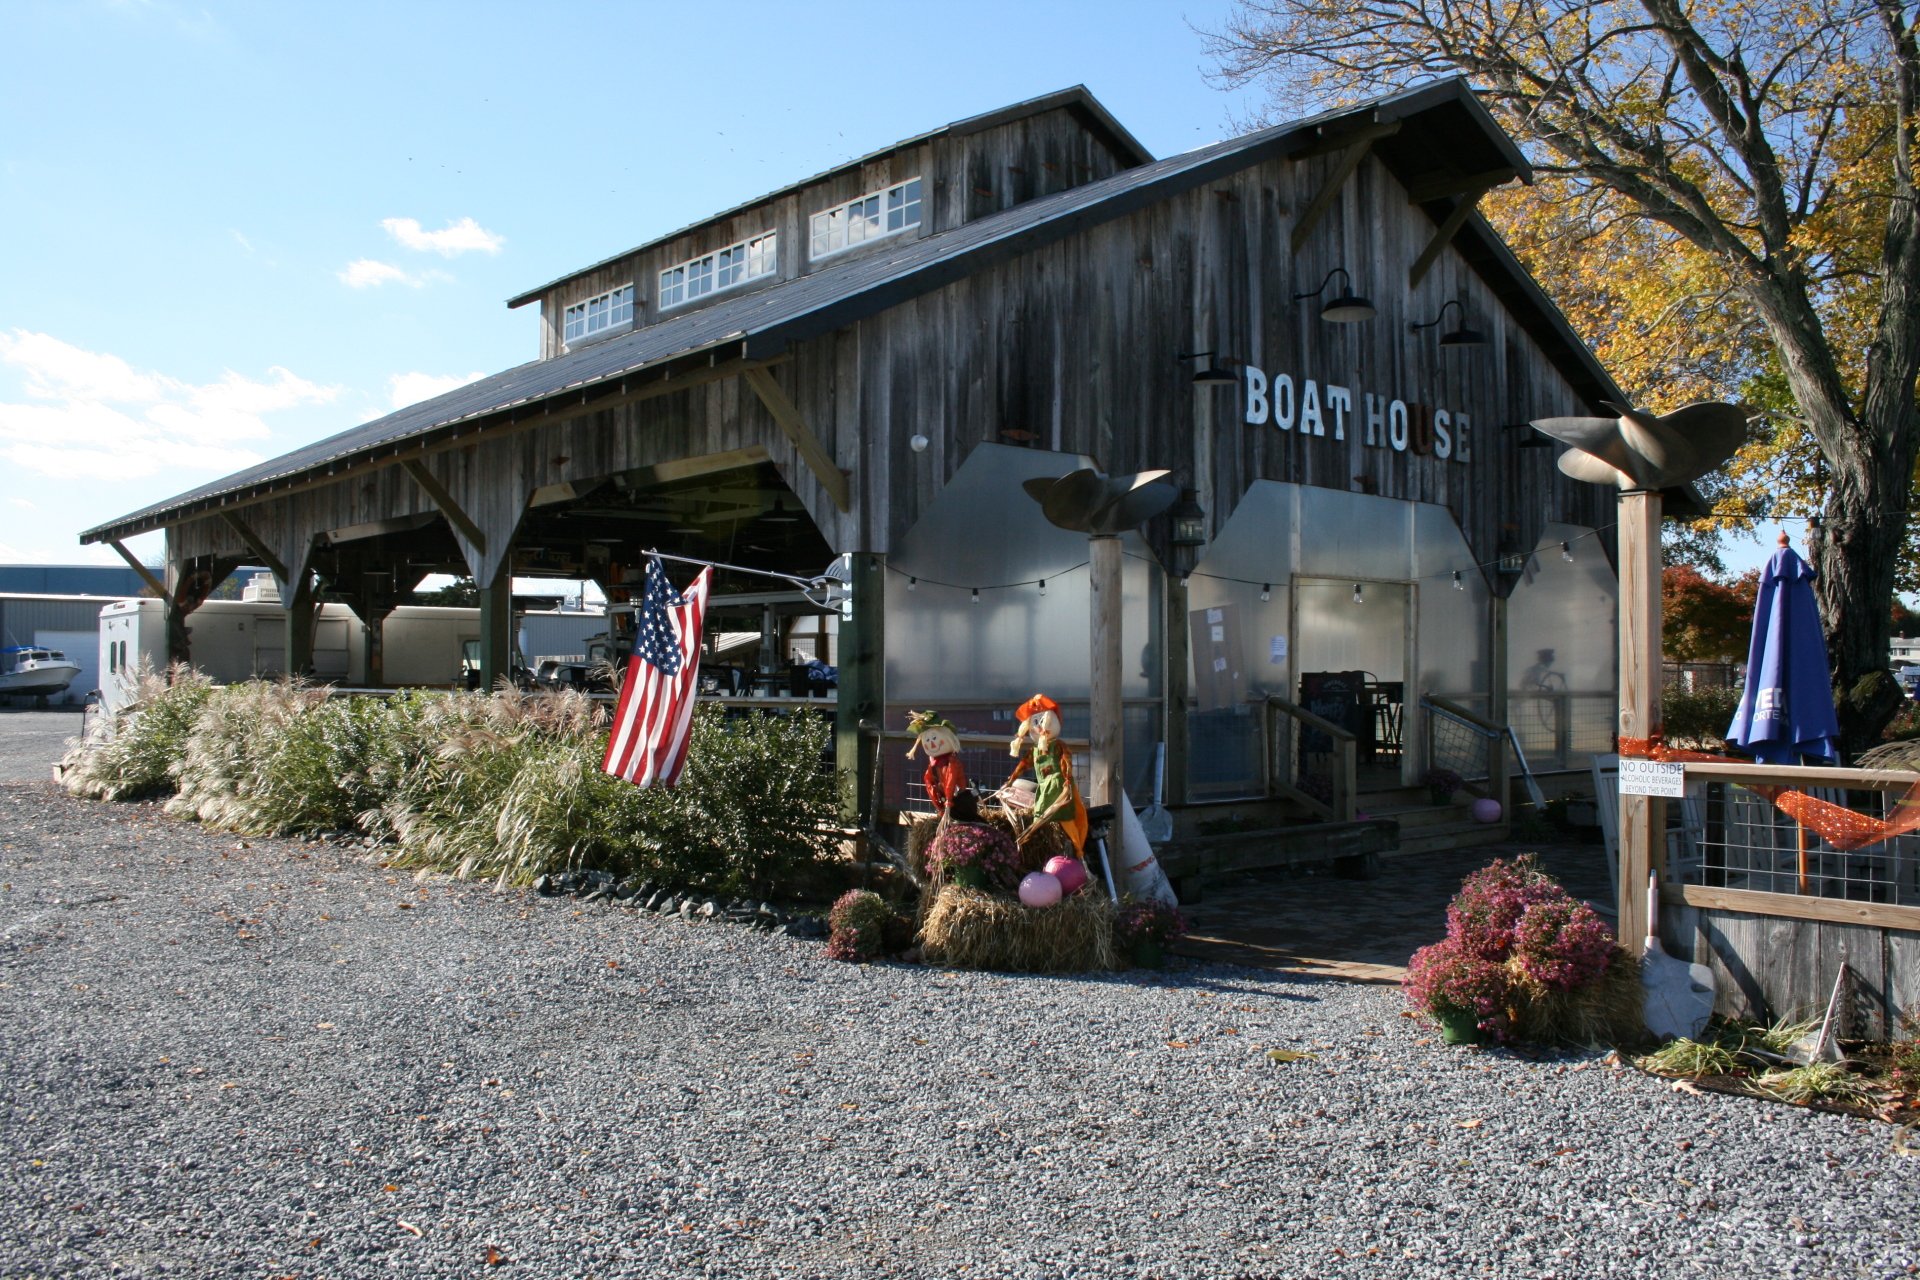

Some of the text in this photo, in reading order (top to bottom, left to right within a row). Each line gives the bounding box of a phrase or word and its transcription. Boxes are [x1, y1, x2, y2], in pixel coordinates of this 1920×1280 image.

[1246, 365, 1471, 463] BOAT HOUSE
[1620, 761, 1683, 775] NO OUTSIDE
[1620, 774, 1682, 786] ALCOHOLIC BEVERAGES
[1625, 785, 1677, 796] BEYOND THIS POINT
